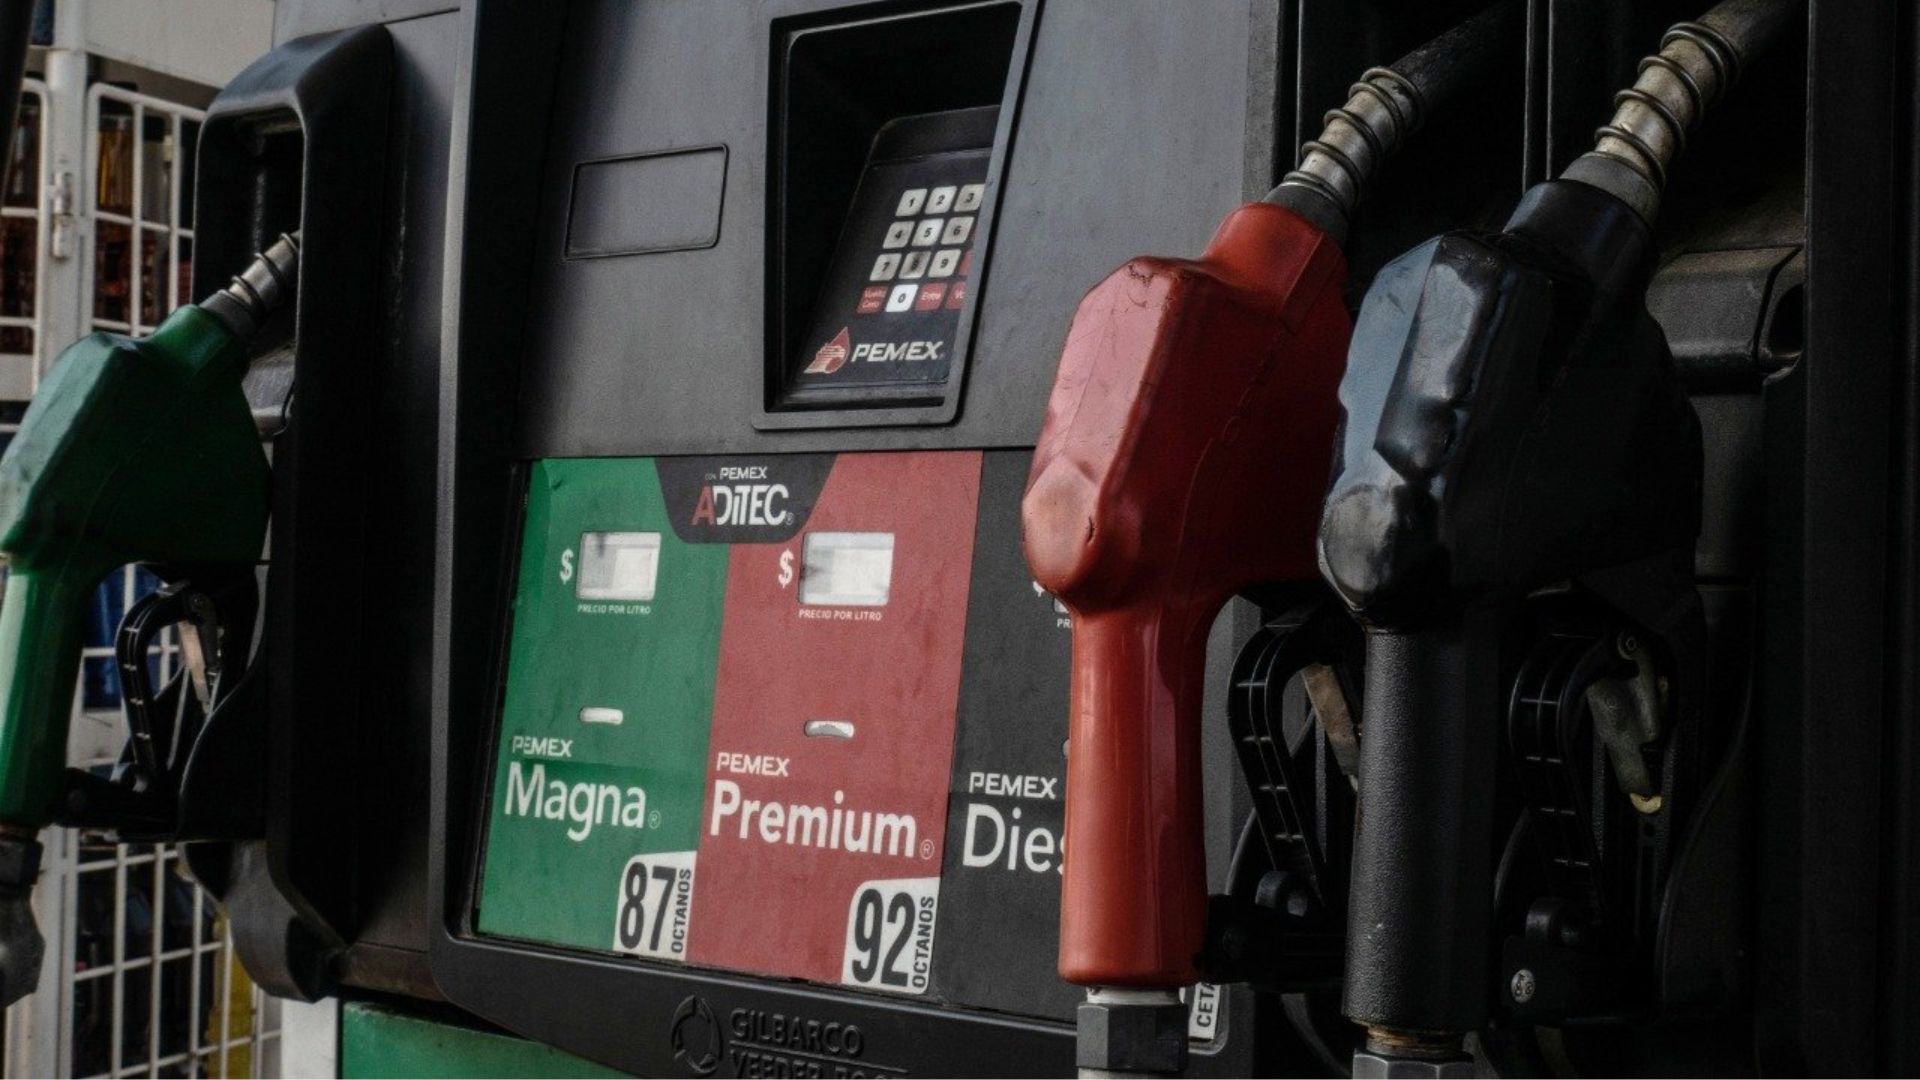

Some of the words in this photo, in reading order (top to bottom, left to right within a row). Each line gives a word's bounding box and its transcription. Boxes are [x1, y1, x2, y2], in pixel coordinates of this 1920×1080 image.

[936, 194, 946, 205] 2
[923, 227, 933, 238] 5
[898, 293, 906, 303] 0
[851, 341, 943, 362] PEMEX
[720, 466, 768, 480] PEMEX
[577, 604, 607, 614] PRECIO
[608, 605, 625, 615] POR
[626, 605, 652, 615] LITRO
[799, 609, 832, 619] PRECIO
[833, 610, 853, 620] POR
[854, 611, 882, 621] LITRO
[512, 736, 573, 757] PEMEX
[716, 752, 790, 777] PEMEX
[968, 772, 1058, 800] PEMEX
[620, 861, 677, 951] 87
[671, 868, 691, 954] OCTANOS
[852, 888, 916, 987] 92
[912, 896, 934, 988] OCTANOS
[730, 1007, 864, 1057] GILBARCO
